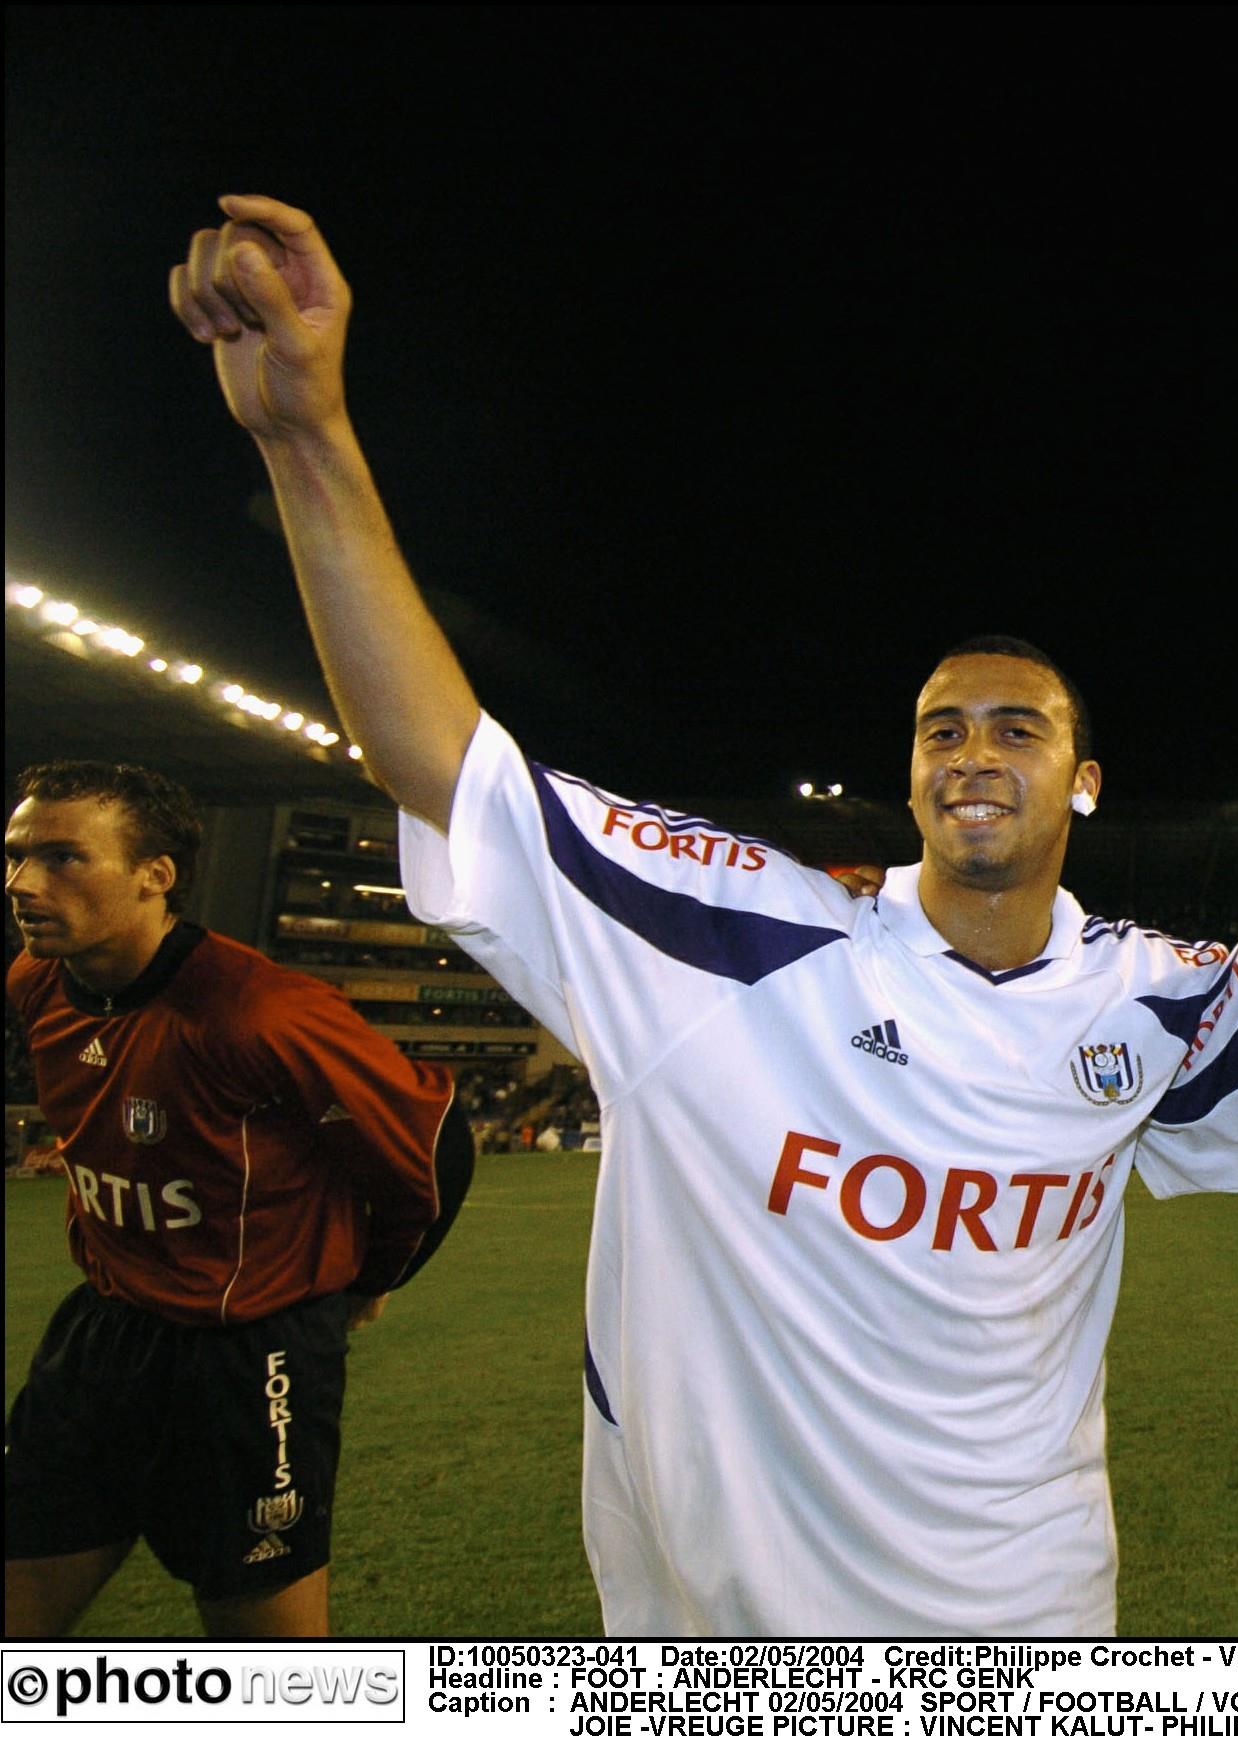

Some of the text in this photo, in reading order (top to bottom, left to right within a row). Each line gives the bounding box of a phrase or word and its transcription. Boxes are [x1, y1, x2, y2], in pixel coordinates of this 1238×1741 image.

[602, 806, 768, 872] FORTIS
[851, 1032, 909, 1067] adidas
[75, 1165, 202, 1231] RTIS
[767, 1130, 1116, 1252] FORTIS
[265, 1350, 292, 1490] FORTIS
